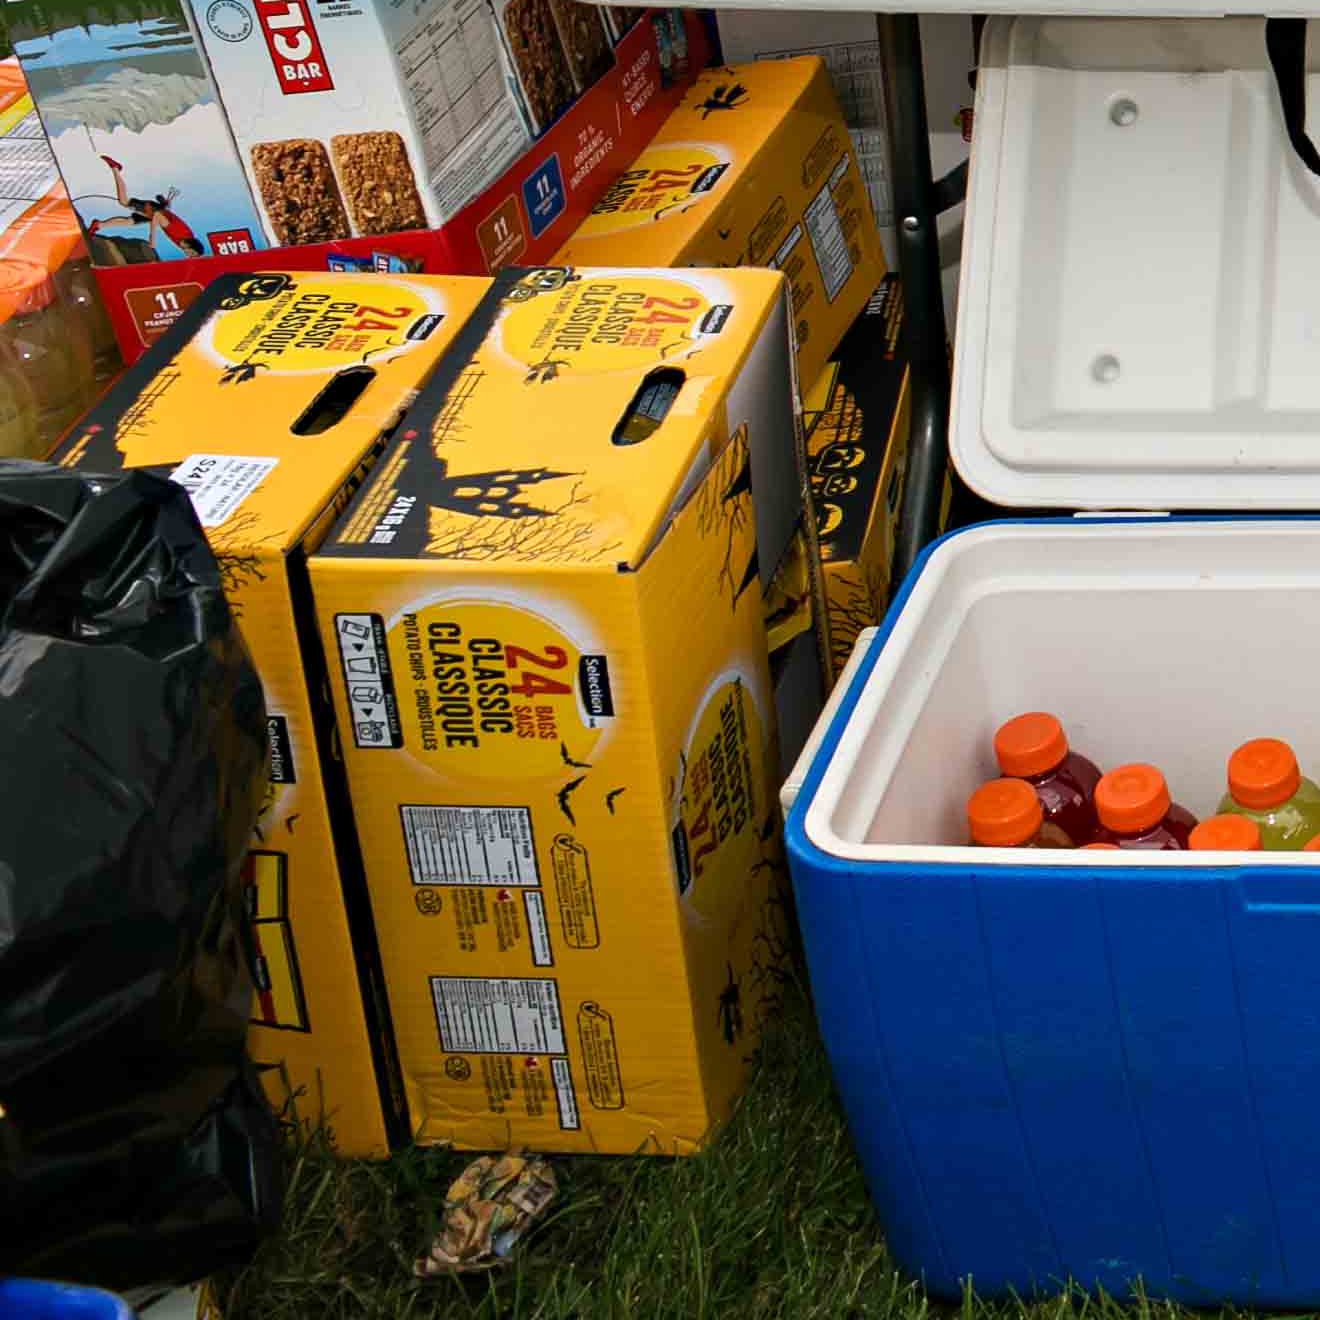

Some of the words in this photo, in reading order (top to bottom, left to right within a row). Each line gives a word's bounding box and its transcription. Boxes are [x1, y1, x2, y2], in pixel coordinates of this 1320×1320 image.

[282, 61, 323, 81] BAR
[153, 290, 181, 312] 11
[252, 293, 331, 357] CLASSIQUE
[294, 301, 359, 350] CLASSIC
[341, 306, 413, 332] 24
[551, 283, 618, 352] CLASSIQUE
[591, 291, 649, 345] CLASSIC
[631, 295, 701, 325] 24
[401, 613, 422, 652] POTATO
[408, 652, 427, 681] CHIPS
[427, 621, 480, 750] CLASSIQUE
[468, 637, 514, 735] CLASSIC
[503, 644, 572, 699] 24
[584, 656, 605, 716] Selection
[415, 687, 438, 753] CROUSTILLES
[513, 704, 536, 740] SACS
[534, 705, 557, 741] BAGS
